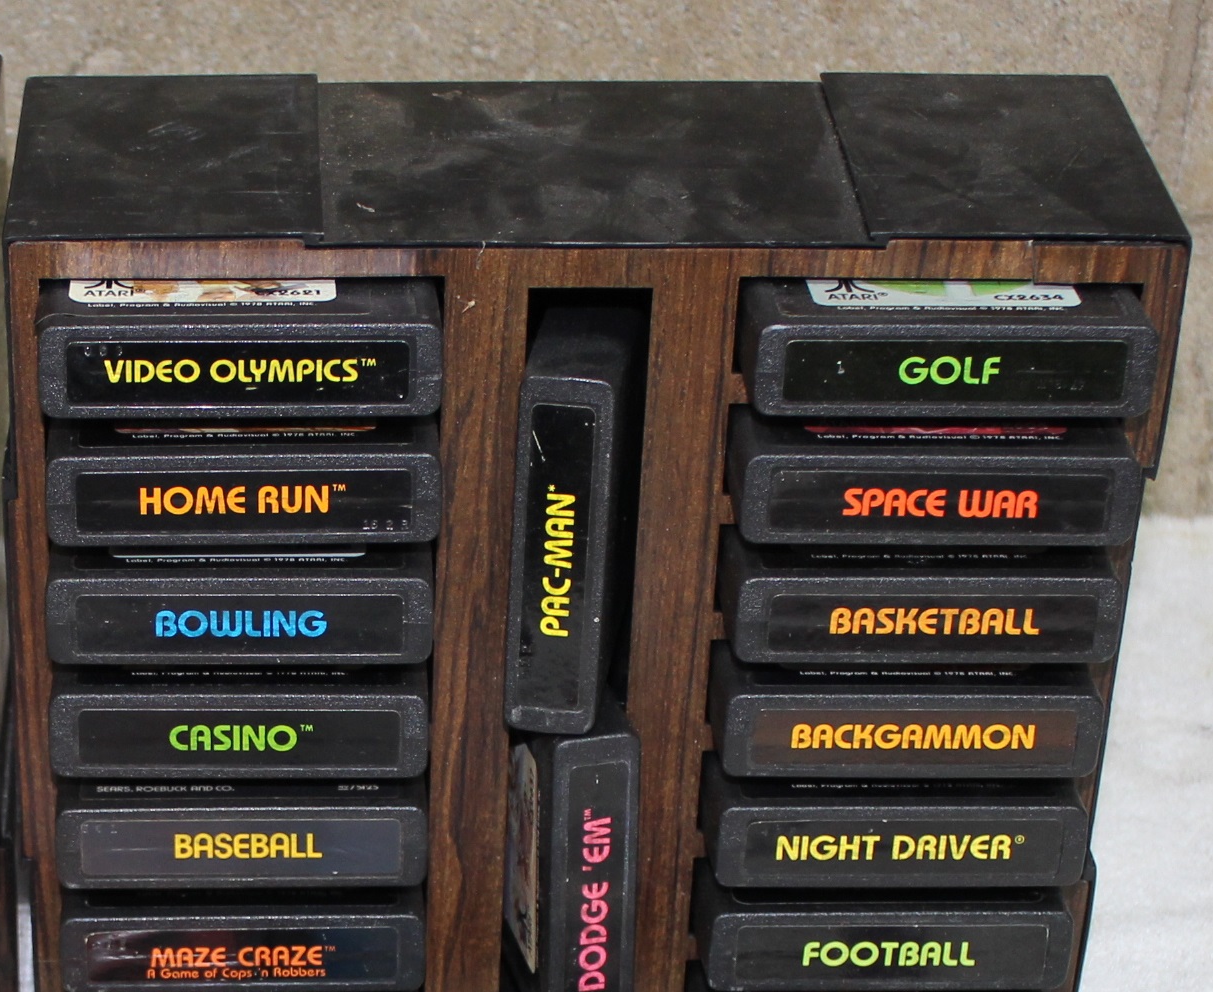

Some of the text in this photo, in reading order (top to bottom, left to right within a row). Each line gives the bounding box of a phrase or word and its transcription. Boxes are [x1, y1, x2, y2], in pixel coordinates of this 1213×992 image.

[994, 293, 1064, 301] CX2634
[104, 359, 200, 384] VIDEO
[898, 356, 1001, 385] GOLF
[140, 486, 245, 515] HOME
[843, 488, 1038, 519] SPACE WAR
[155, 610, 327, 638] BOWLING
[829, 607, 1039, 635] BASKETBALL
[791, 724, 1035, 749] BACKGAMMON
[174, 833, 322, 859] BASEBALL
[775, 835, 880, 861] NIGHT
[578, 881, 609, 992] DODGE
[150, 947, 227, 968] MAZE
[802, 941, 975, 967] FOOTBALL
[147, 970, 155, 979] A
[160, 969, 199, 979] Game
[205, 968, 218, 979] of
[222, 968, 252, 980] Cops
[274, 967, 326, 977] Robbers
